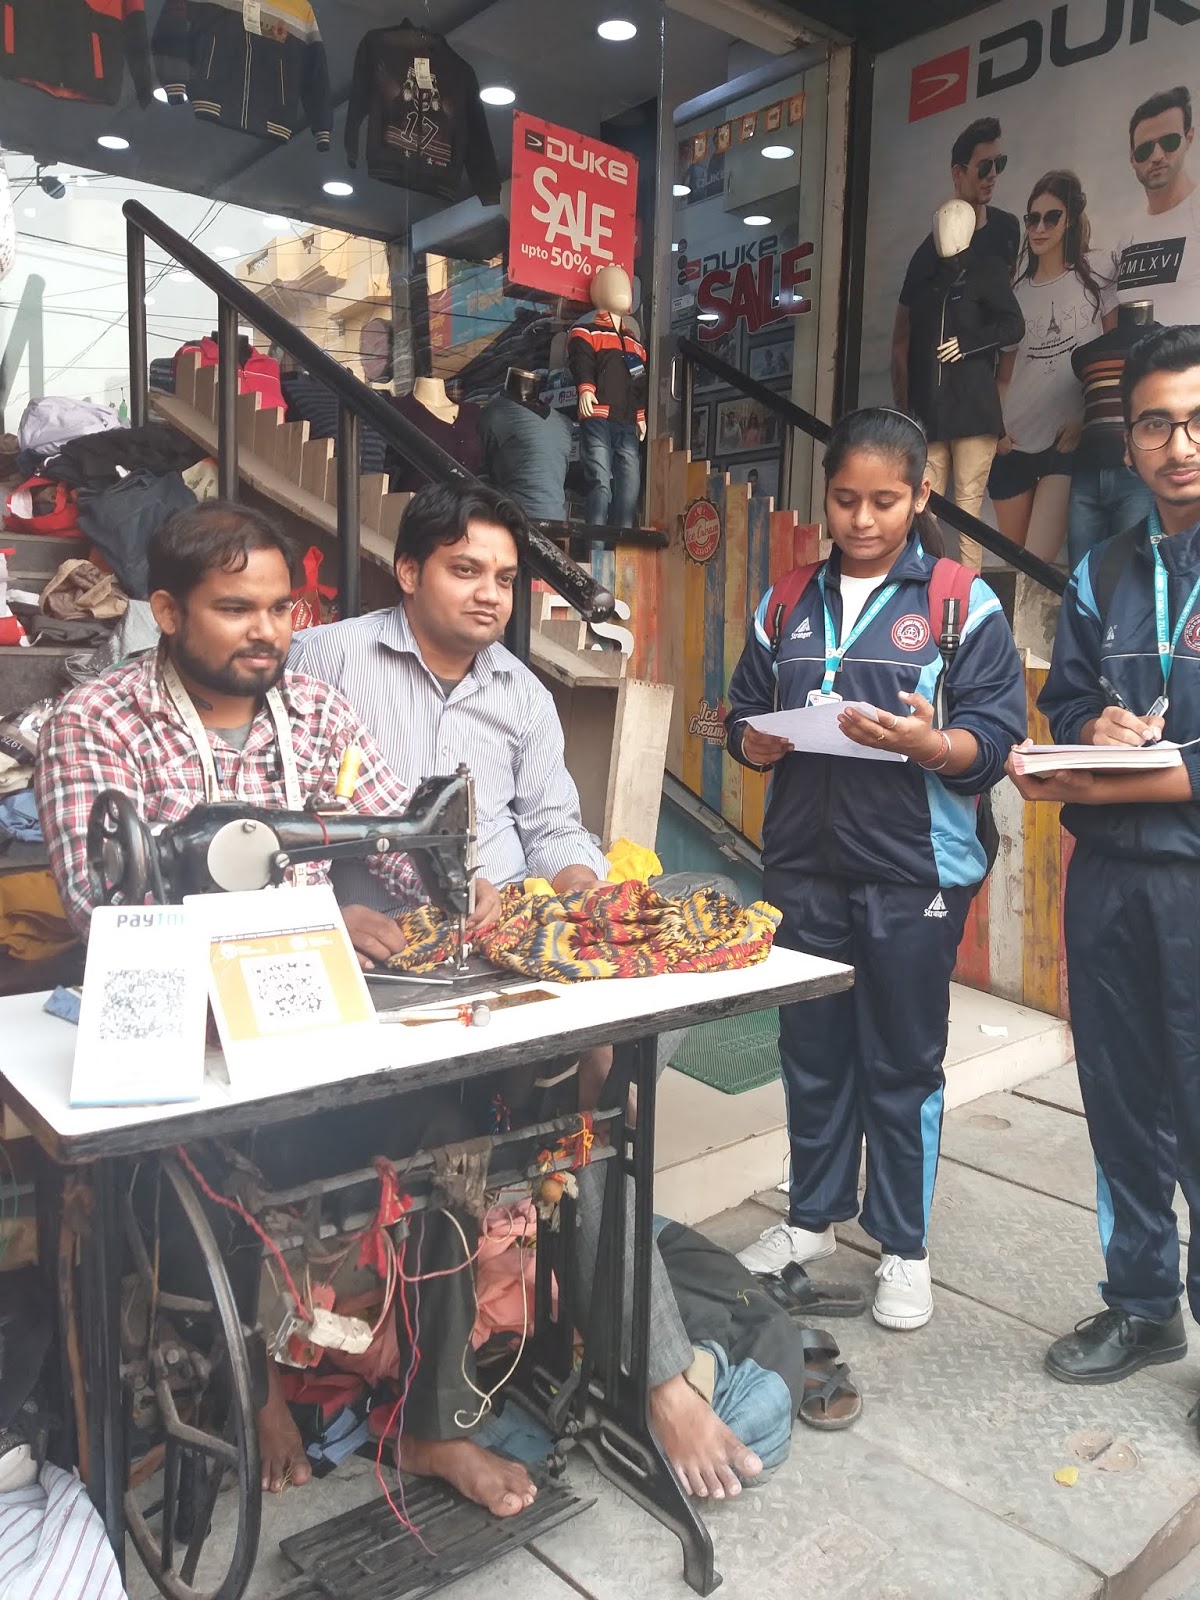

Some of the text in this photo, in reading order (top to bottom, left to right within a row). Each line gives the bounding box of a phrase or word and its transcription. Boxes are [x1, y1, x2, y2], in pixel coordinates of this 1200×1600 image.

[400, 111, 439, 150] 17
[531, 166, 616, 260] SALE
[521, 243, 549, 260] upto
[550, 246, 592, 276] 50%
[697, 242, 815, 342] SALE
[689, 715, 726, 739] Cream
[699, 700, 719, 721] Ice
